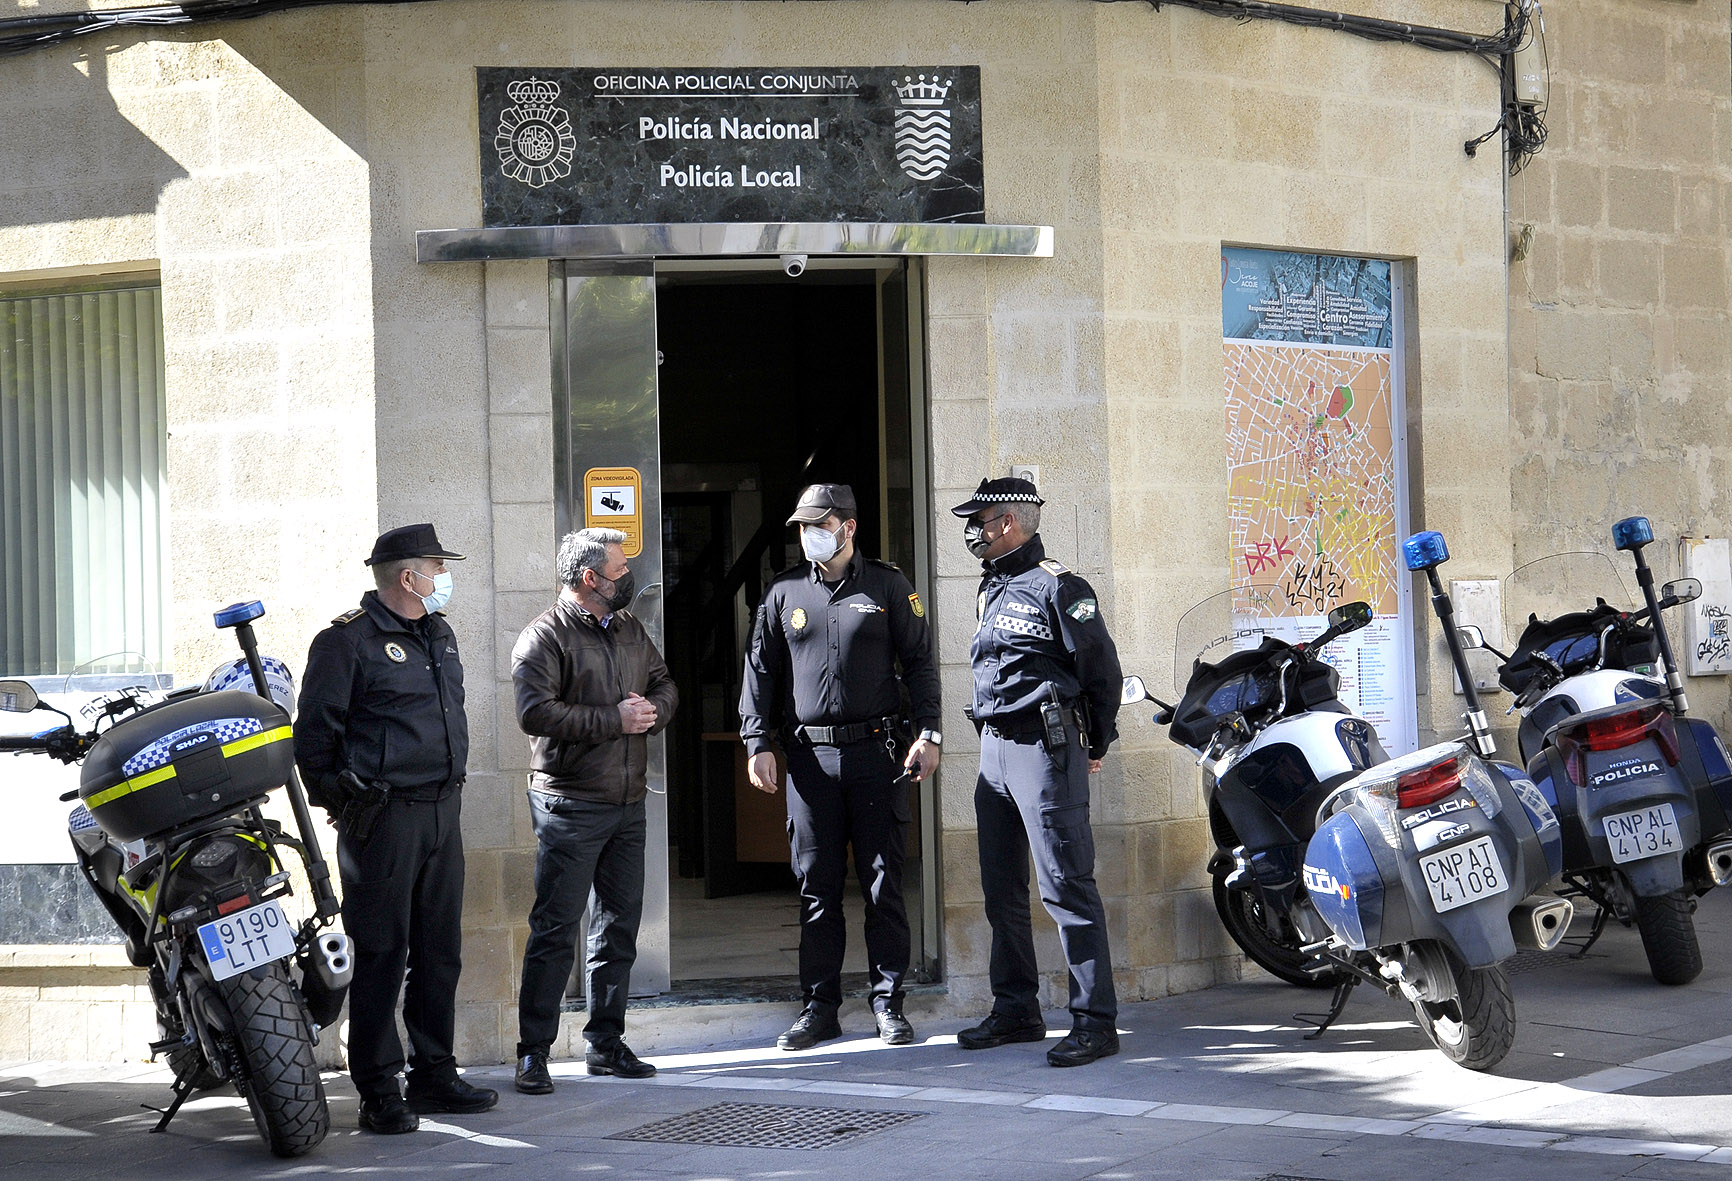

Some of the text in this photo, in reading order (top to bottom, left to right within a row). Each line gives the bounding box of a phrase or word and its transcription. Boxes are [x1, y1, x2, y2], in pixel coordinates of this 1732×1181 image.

[593, 75, 859, 92] OFICINA POLICIAL CONJUNTA
[638, 116, 820, 141] Policía Nacional
[659, 164, 802, 188] Policía Local
[1320, 310, 1349, 324] Centro
[176, 734, 208, 751] SHAD
[1594, 763, 1660, 785] POLICIA
[1609, 758, 1642, 769] HONDA
[1439, 823, 1470, 841] CNP
[1608, 809, 1673, 838] CNP AL
[1619, 829, 1673, 855] 4134
[1426, 842, 1489, 884] CNP AT
[1440, 866, 1498, 902] 4108
[220, 907, 279, 944] 9190
[226, 934, 271, 969] LTT
